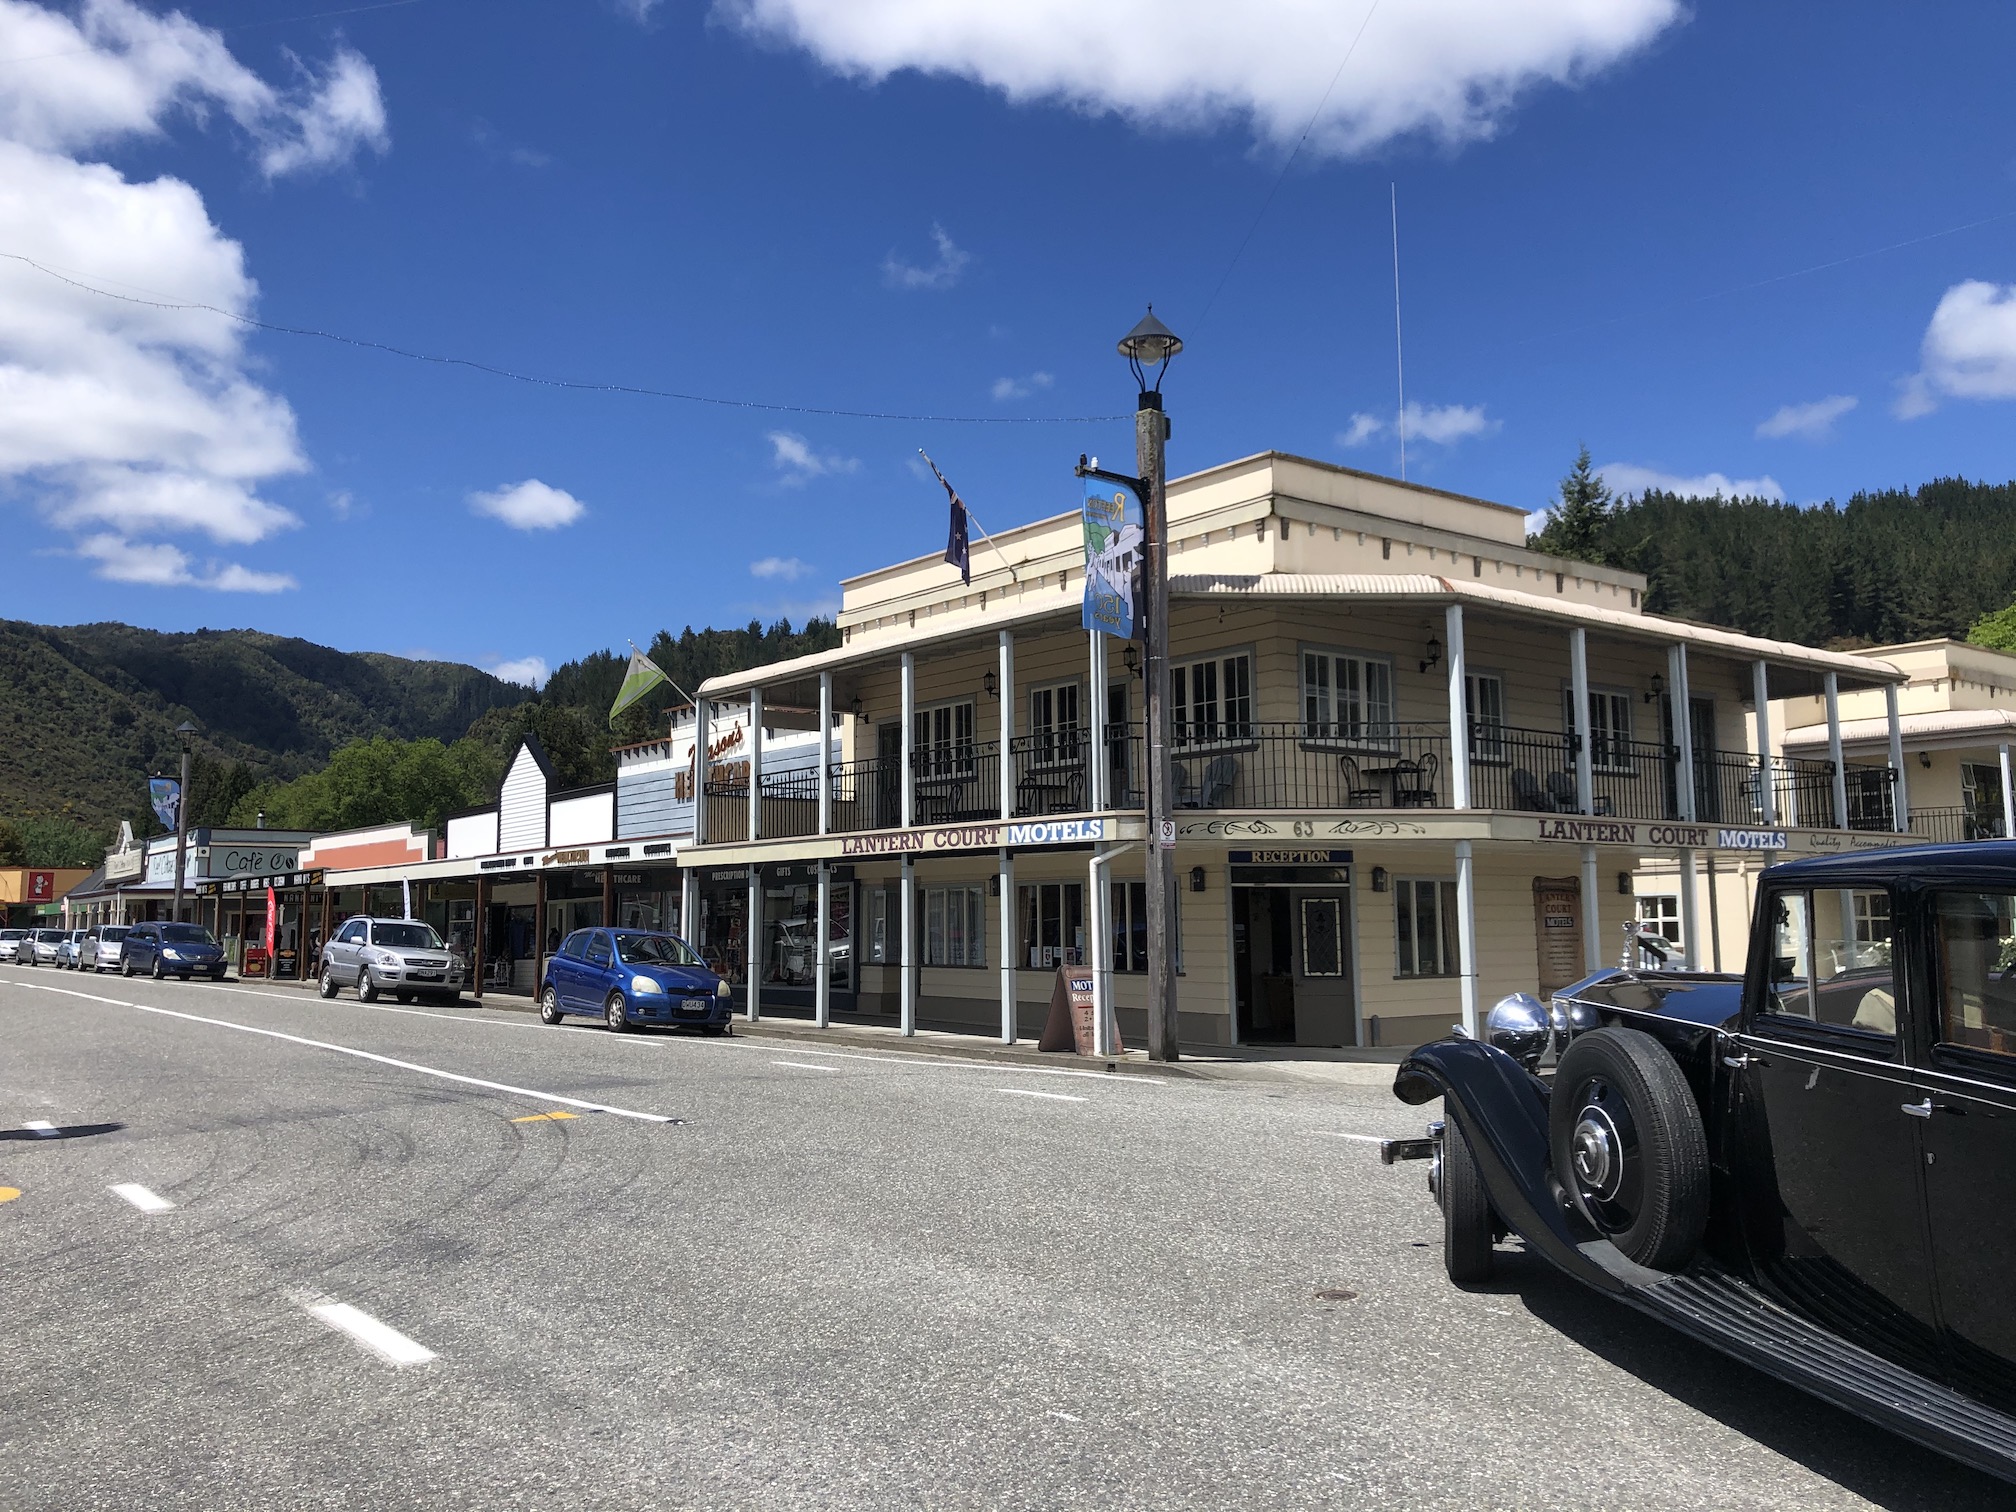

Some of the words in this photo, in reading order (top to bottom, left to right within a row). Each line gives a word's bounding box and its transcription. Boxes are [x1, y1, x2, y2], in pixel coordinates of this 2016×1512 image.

[1294, 821, 1314, 837] 63
[1539, 820, 1636, 842] LANTERN
[1649, 827, 1708, 846] COURT
[1720, 830, 1786, 849] MOTELS
[842, 831, 925, 854] LANTERN
[934, 827, 1000, 847] COURT
[1009, 820, 1101, 844] MOTELS
[1810, 834, 1841, 850] Quality
[1252, 851, 1330, 863] RECEPTION
[712, 870, 745, 881] PRESCRIPTION
[776, 867, 791, 877] GIFTS
[1545, 904, 1571, 913] COURT
[1546, 917, 1573, 927] MOTELS
